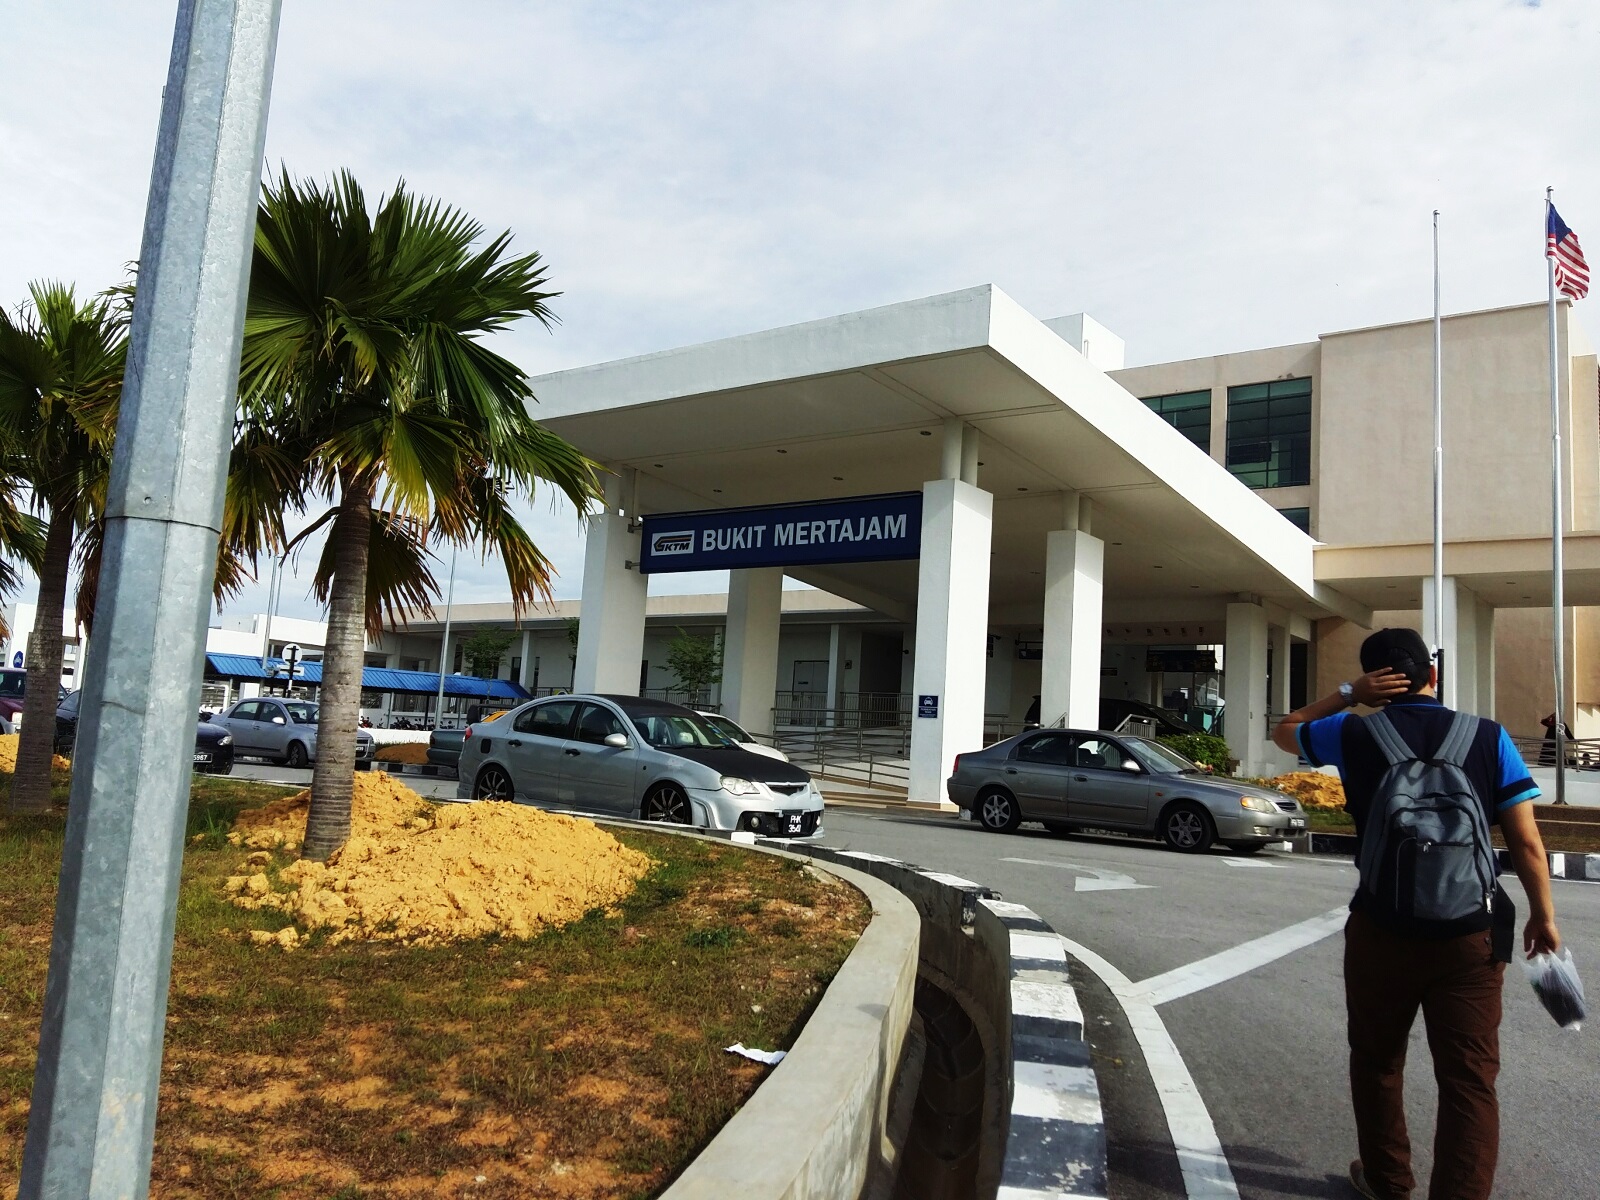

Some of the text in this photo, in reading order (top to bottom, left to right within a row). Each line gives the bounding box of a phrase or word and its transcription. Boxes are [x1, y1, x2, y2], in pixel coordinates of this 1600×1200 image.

[664, 514, 907, 552] KTM BUKIT MERTAJAM
[790, 815, 802, 823] PHK
